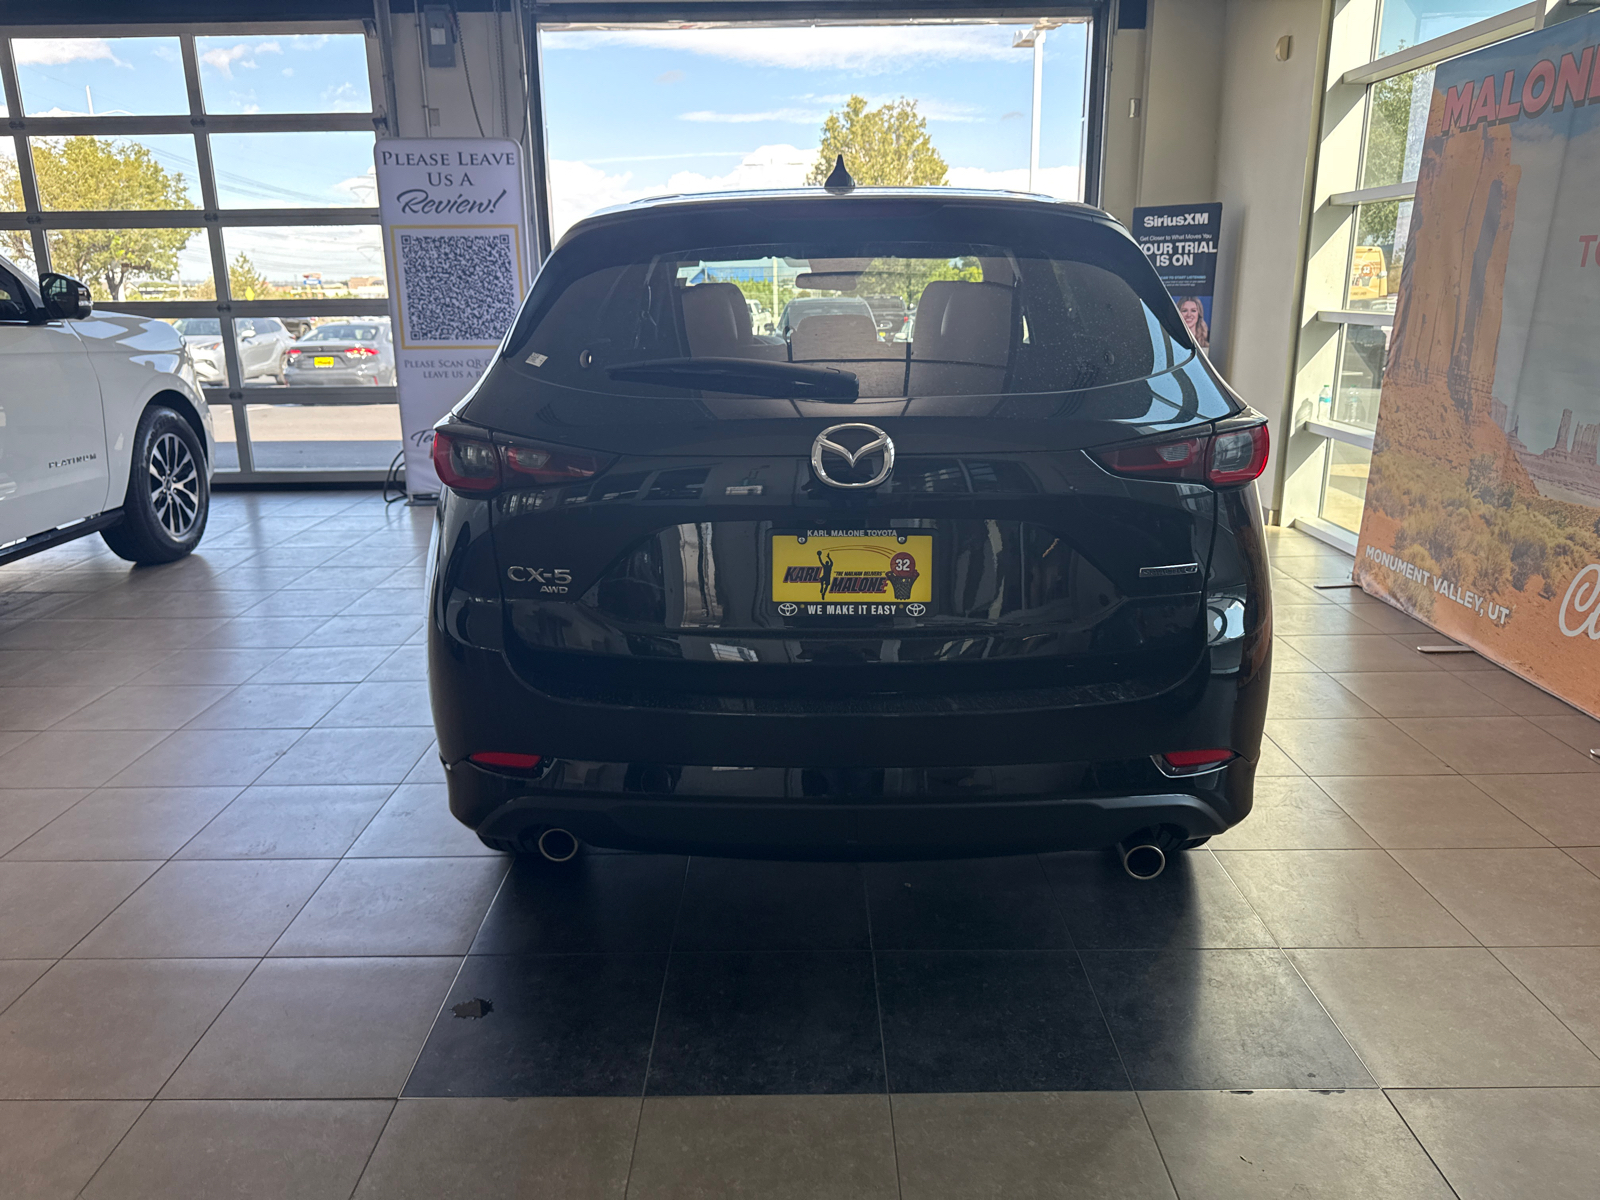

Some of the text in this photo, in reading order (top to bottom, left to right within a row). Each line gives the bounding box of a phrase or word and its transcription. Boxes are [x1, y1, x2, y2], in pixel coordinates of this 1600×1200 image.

[382, 151, 515, 166] PLEASE LEAVE
[427, 172, 474, 187] US A
[396, 188, 507, 214] Review!
[1144, 213, 1209, 227] SiriusXM
[1176, 241, 1217, 254] TRIAL
[1156, 253, 1194, 266] IS ON
[404, 359, 435, 368] PLEASE
[438, 359, 463, 368] SCAN
[466, 358, 482, 369] QR
[423, 371, 448, 379] LEAVE
[48, 453, 97, 469] PLATINUM
[895, 559, 910, 571] 32
[507, 566, 572, 585] CX-5
[783, 566, 823, 583] KARL
[540, 585, 568, 594] AWD
[829, 576, 888, 594] MALONE
[1365, 545, 1509, 625] MONUMENT VALLEY, UT
[808, 604, 896, 615] WE MAKE IT EASY
